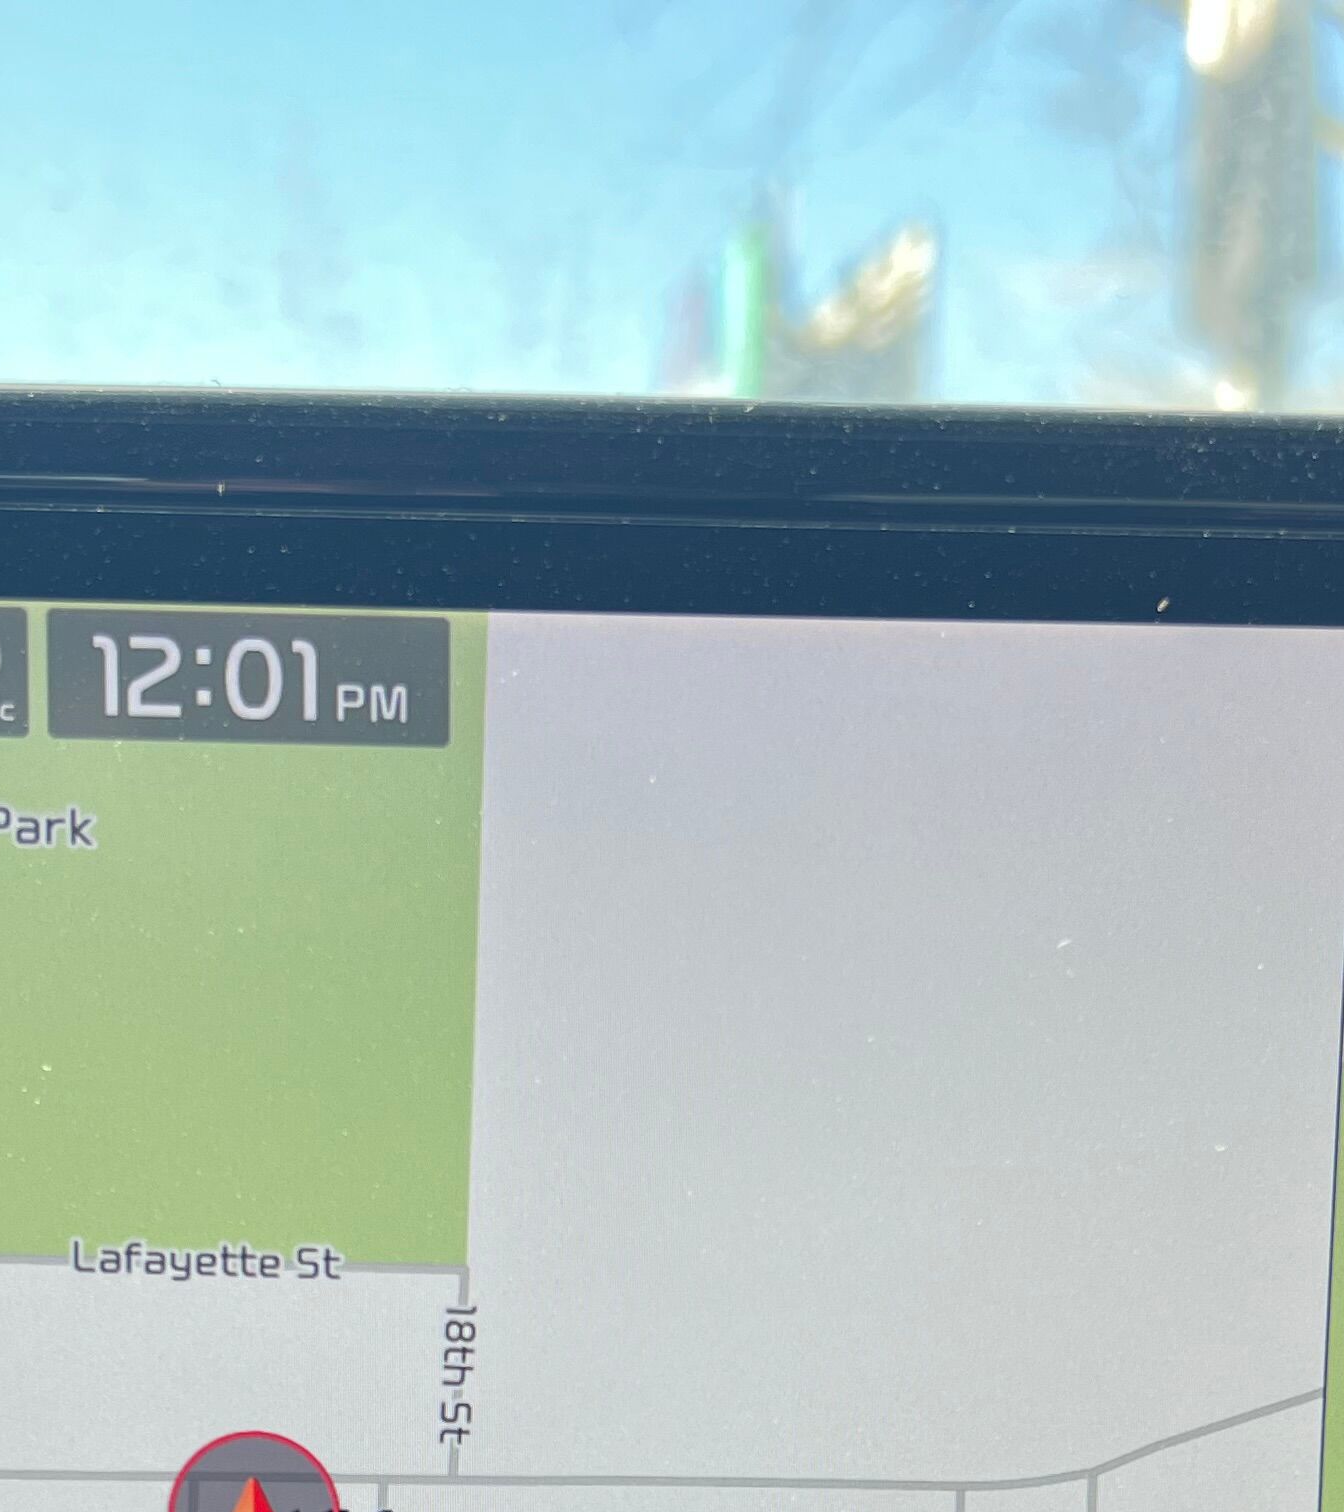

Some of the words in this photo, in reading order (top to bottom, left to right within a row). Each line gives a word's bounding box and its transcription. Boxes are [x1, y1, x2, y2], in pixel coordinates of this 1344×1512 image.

[92, 634, 319, 722] 12:01
[336, 685, 409, 724] PM
[73, 1240, 281, 1281] Lafayette
[296, 1245, 343, 1281] St
[443, 1306, 478, 1388] 18th
[440, 1401, 474, 1445] St
